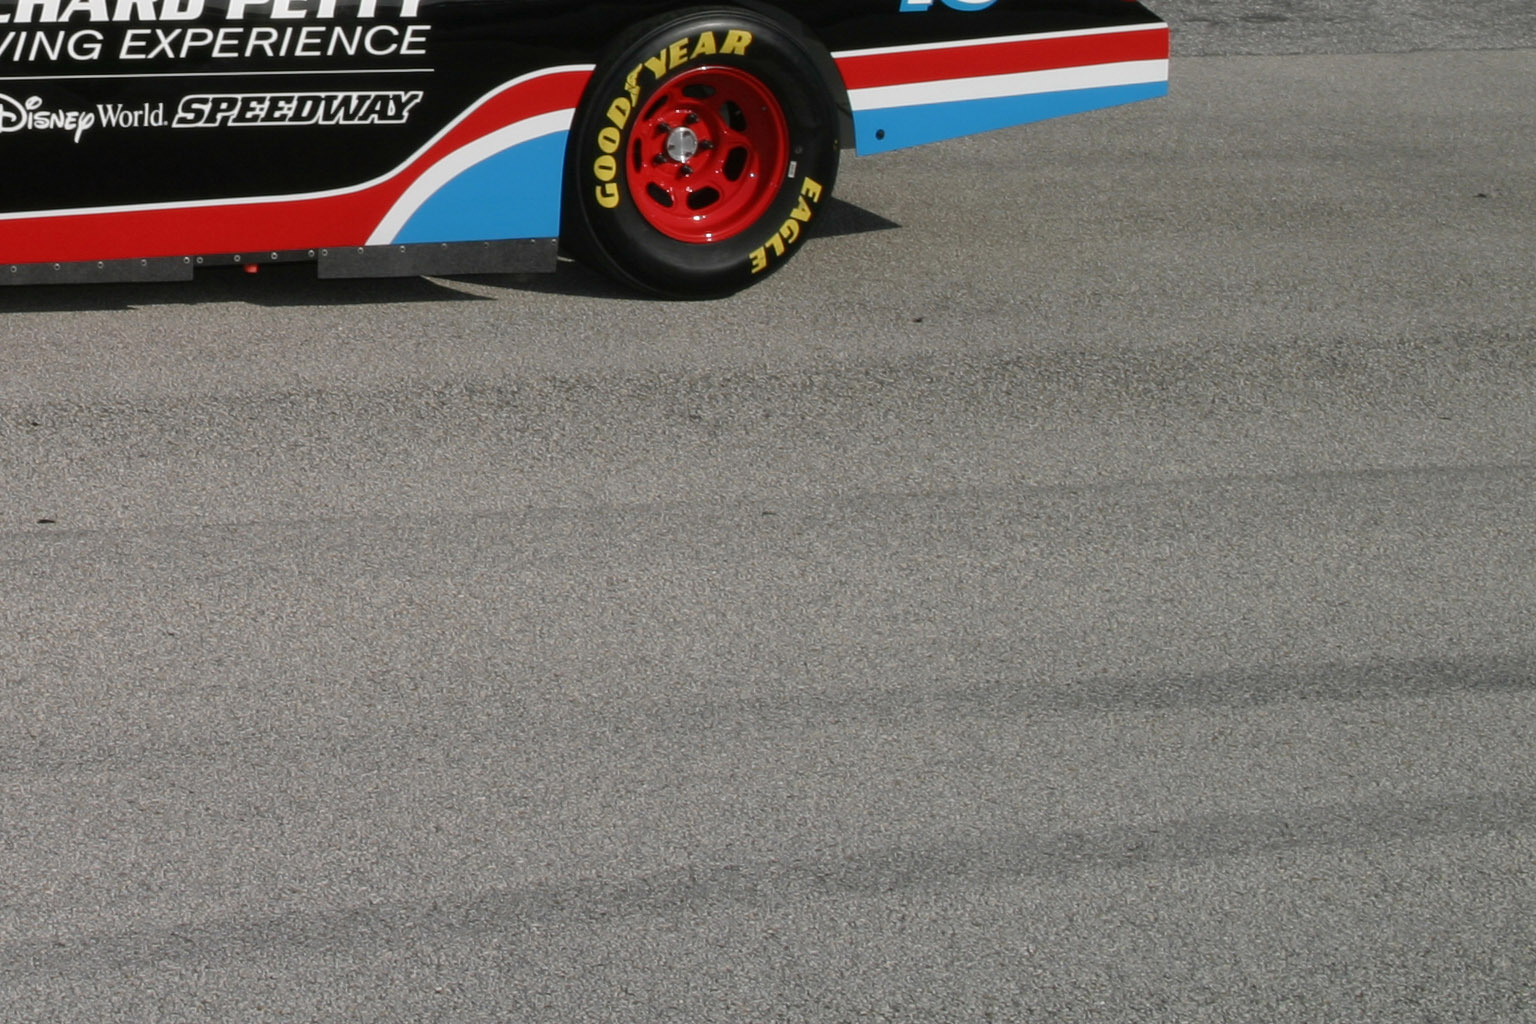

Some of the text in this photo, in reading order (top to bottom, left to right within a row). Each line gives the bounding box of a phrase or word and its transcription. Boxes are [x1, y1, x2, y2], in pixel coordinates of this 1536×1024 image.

[119, 25, 431, 61] EXPERIENCE
[172, 91, 424, 128] SPEEDWAY
[594, 29, 753, 209] GOODYEAR
[749, 176, 823, 274] EAGLE
